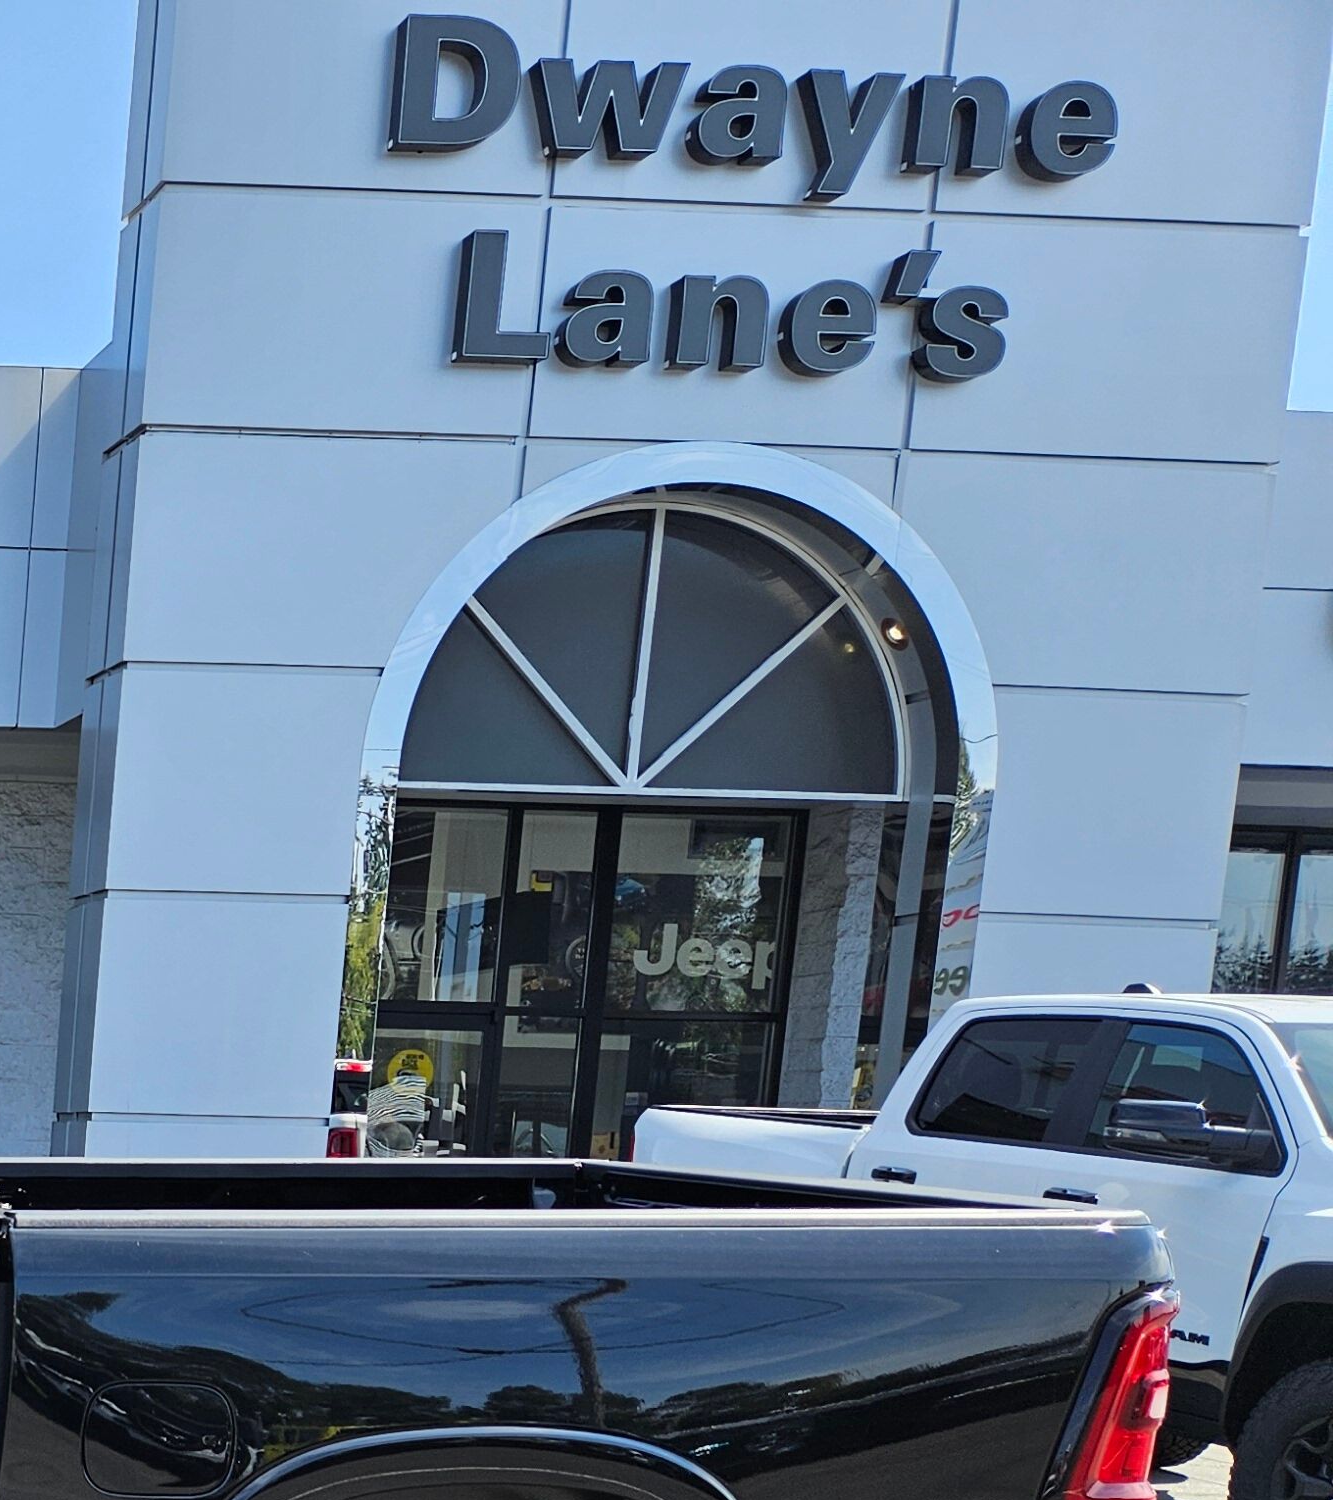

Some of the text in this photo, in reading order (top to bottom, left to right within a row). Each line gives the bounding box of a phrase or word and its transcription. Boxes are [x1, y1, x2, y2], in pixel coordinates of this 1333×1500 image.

[387, 14, 1119, 202] Dwayne
[450, 229, 1010, 383] Lane's
[634, 923, 777, 990] Jeep
[1169, 1328, 1210, 1347] AM
